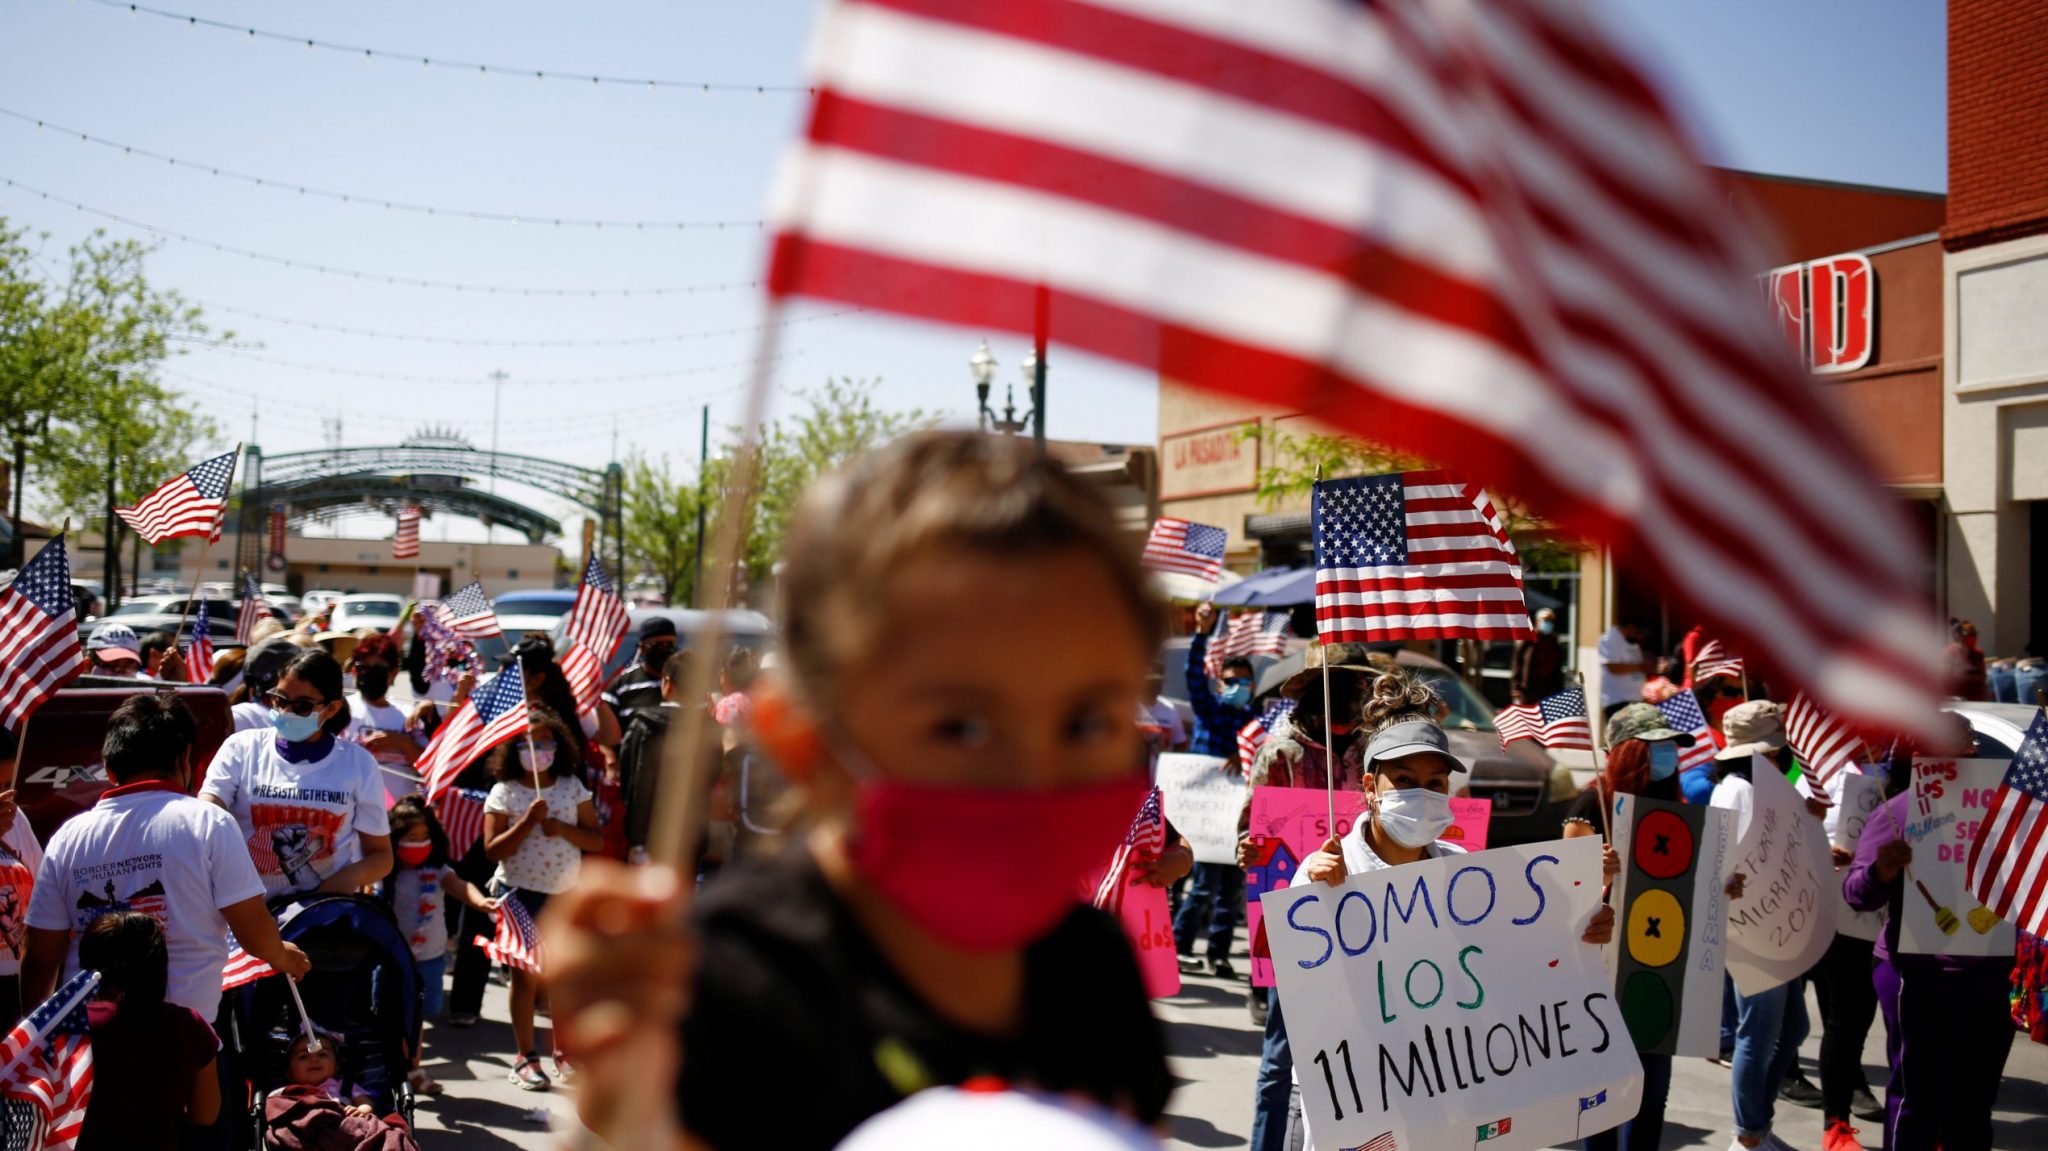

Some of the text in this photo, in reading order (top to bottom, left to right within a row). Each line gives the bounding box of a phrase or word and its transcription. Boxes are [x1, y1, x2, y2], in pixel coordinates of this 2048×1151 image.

[132, 861, 162, 872] RGHTS
[1732, 807, 1778, 890] EFORMA
[1287, 854, 1560, 970] SOMOS
[1769, 869, 1821, 948] 2021
[1377, 945, 1485, 1024] LOS
[1314, 992, 1611, 1121] 11 MILLONES
